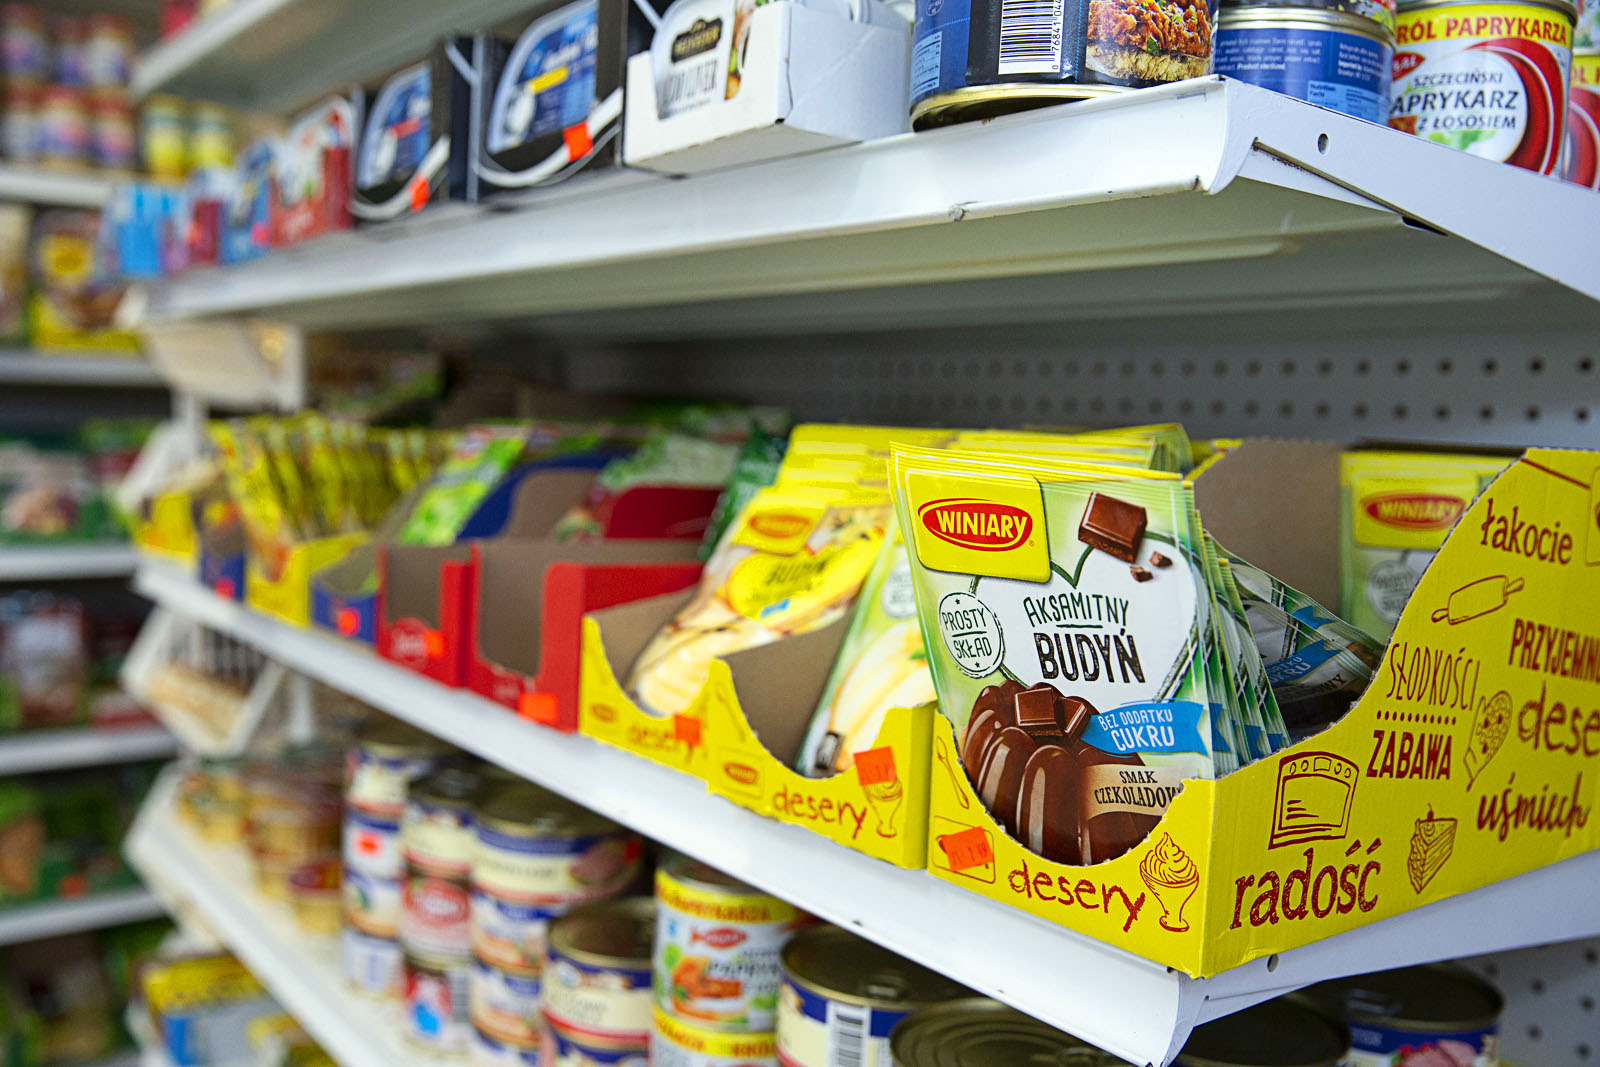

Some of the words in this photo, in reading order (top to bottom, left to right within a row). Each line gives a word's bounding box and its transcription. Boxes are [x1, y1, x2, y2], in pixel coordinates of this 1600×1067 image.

[1051, 21, 1062, 52] 76841
[1395, 18, 1438, 45] RÓL
[1445, 16, 1567, 46] PAPRYKARZA
[1413, 68, 1504, 89] SZCZECIŃSKI
[1390, 90, 1520, 115] APRYKARZ
[1416, 117, 1428, 131] Z
[1433, 115, 1517, 130] ŁOSOSIEM
[935, 509, 1028, 539] WINIARY
[1480, 498, 1574, 565] łakocie
[941, 607, 988, 632] PROSTY
[1023, 592, 1130, 628] AKSAMITNY
[953, 635, 993, 660] SKŁAD
[1033, 628, 1147, 683] BUDYŃ
[1508, 618, 1600, 684] PRZYJEMN
[1386, 642, 1481, 711] SŁODKOŚCI
[1098, 713, 1120, 732] BEZ
[1119, 708, 1174, 726] DODATKU
[1517, 680, 1600, 757] dese
[1110, 725, 1175, 751] CUKRU
[1366, 730, 1453, 780] ZABAWA
[1119, 770, 1159, 784] SMAK
[772, 783, 867, 840] desery
[1094, 785, 1181, 808] CZEKOLADOW
[1476, 772, 1592, 842] uśmiech
[1008, 859, 1146, 933] desery
[1229, 838, 1382, 930] radość
